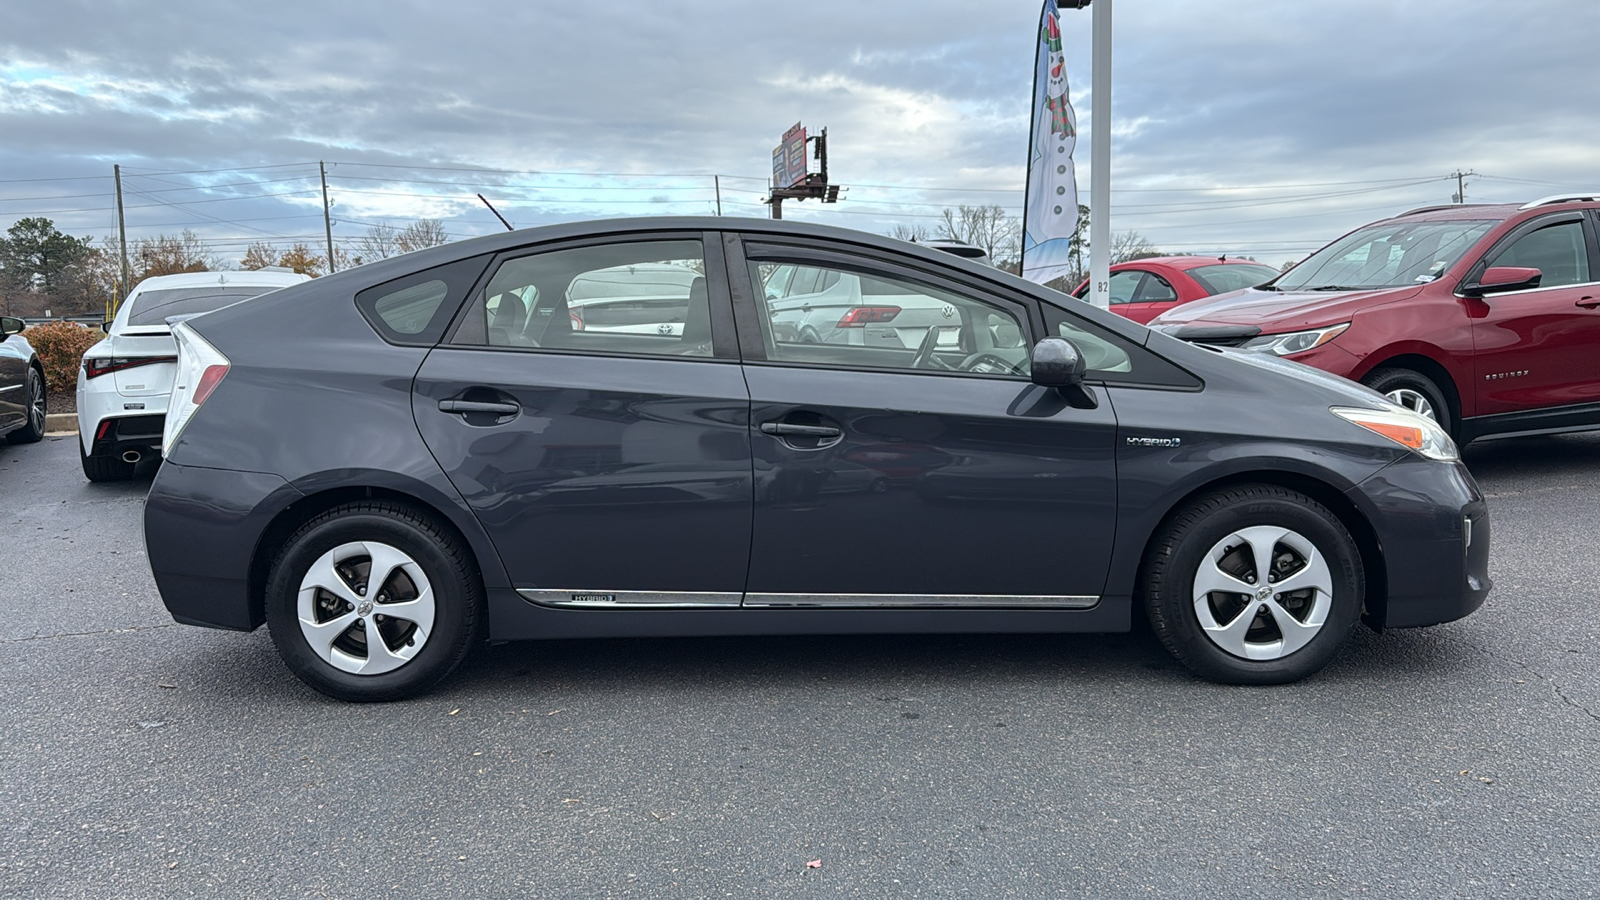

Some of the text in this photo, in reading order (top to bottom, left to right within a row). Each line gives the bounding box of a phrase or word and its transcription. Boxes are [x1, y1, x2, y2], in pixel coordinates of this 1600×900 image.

[1098, 281, 1108, 293] B2
[1485, 369, 1529, 381] EQUINOX
[1126, 437, 1171, 447] HYBRID
